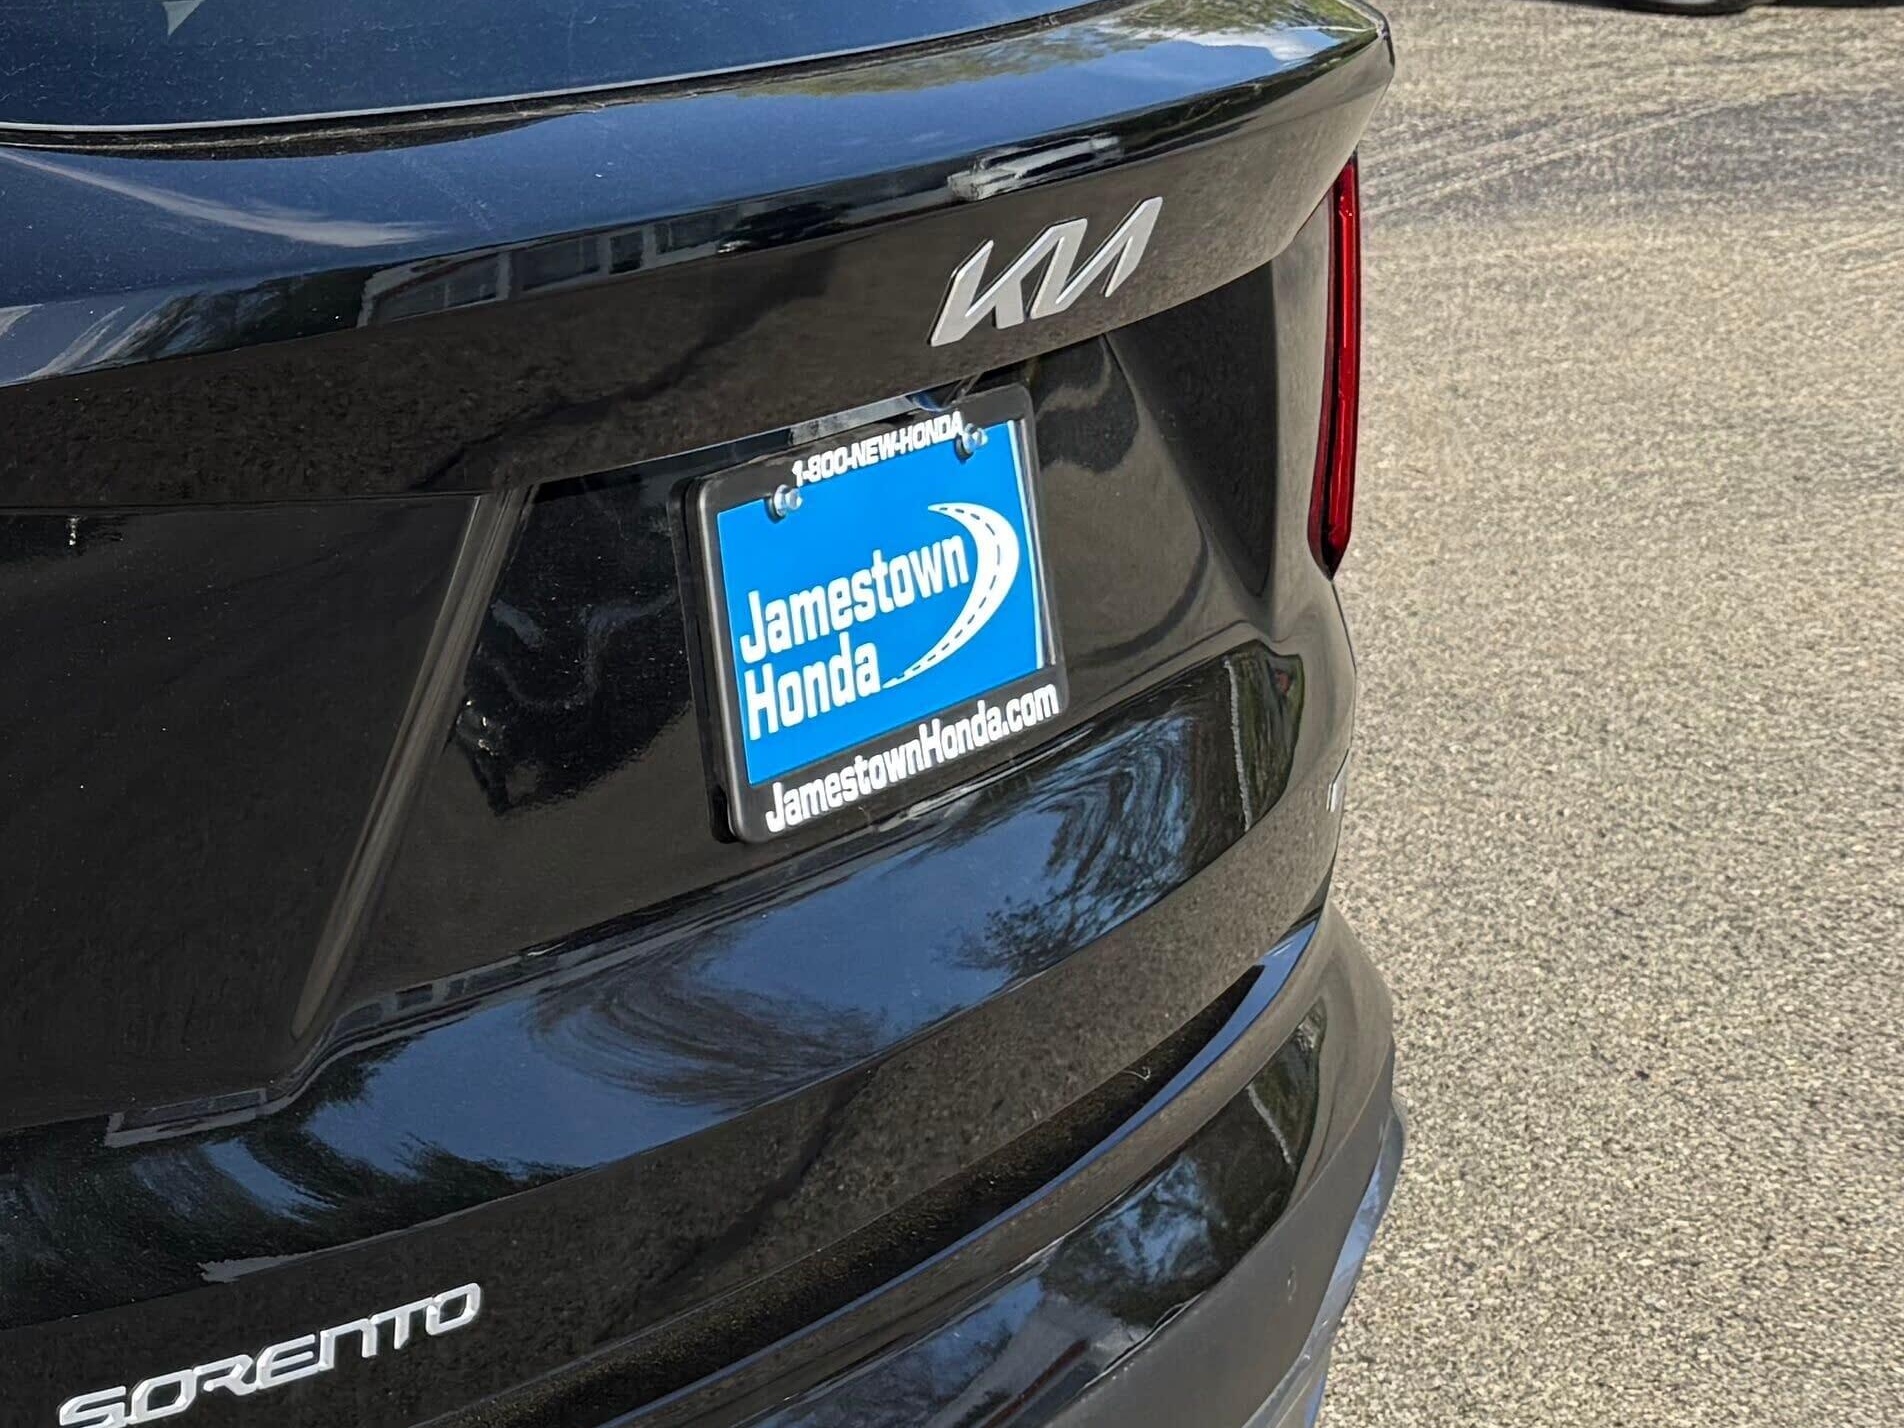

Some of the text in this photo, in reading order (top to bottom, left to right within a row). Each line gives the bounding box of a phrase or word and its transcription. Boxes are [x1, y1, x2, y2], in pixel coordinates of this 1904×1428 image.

[926, 195, 1163, 347] KIA
[792, 410, 963, 487] 1-800-NEW-HONDA
[739, 532, 969, 664] Jamestown
[743, 629, 882, 741] Honda
[764, 683, 1060, 832] JamestownHonda.com
